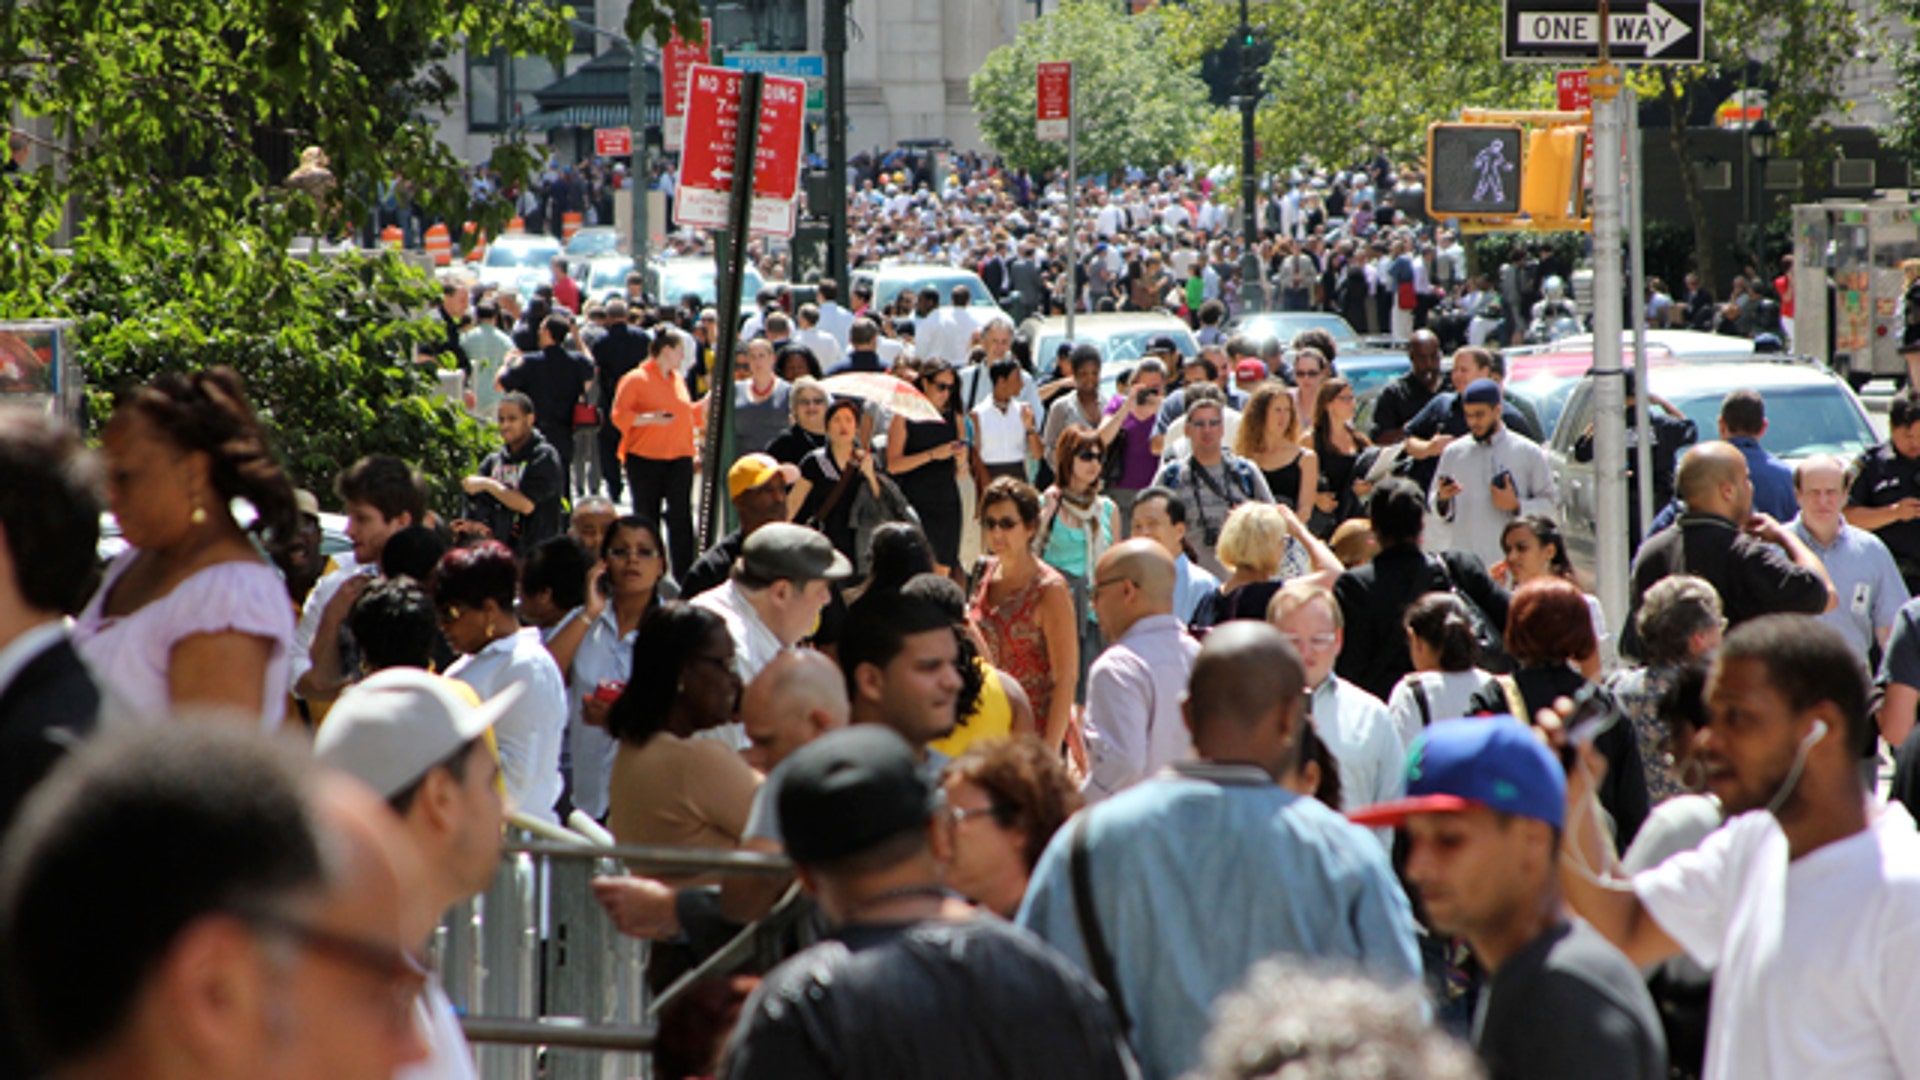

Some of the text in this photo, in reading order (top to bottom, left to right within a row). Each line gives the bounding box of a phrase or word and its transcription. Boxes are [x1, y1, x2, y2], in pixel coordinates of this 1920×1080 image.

[1533, 17, 1673, 41] ONE WAY
[698, 74, 719, 93] NO
[726, 78, 797, 104] STDING
